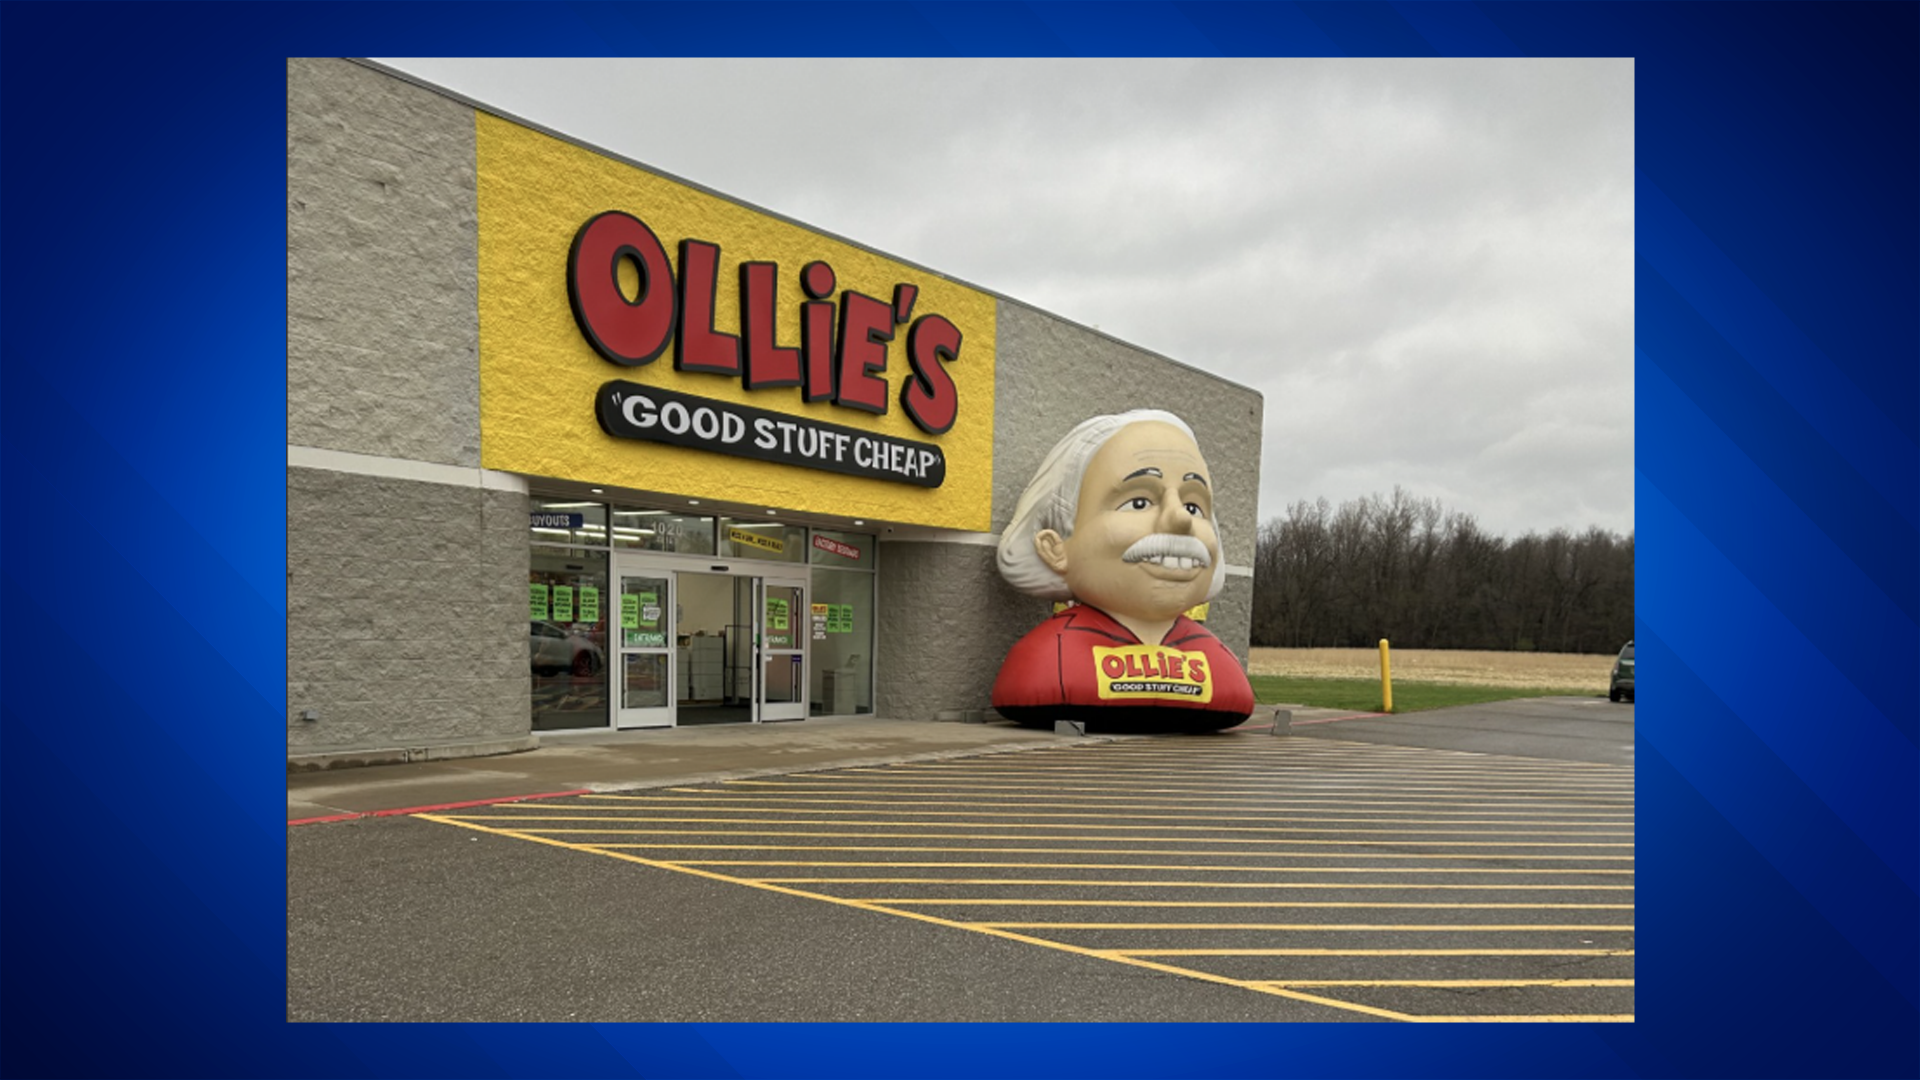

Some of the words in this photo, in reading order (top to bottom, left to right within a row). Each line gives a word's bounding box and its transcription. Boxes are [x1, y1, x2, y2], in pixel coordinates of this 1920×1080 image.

[754, 419, 851, 463] STUFF
[651, 520, 683, 537] 1020
[1145, 684, 1171, 692] STUFF
